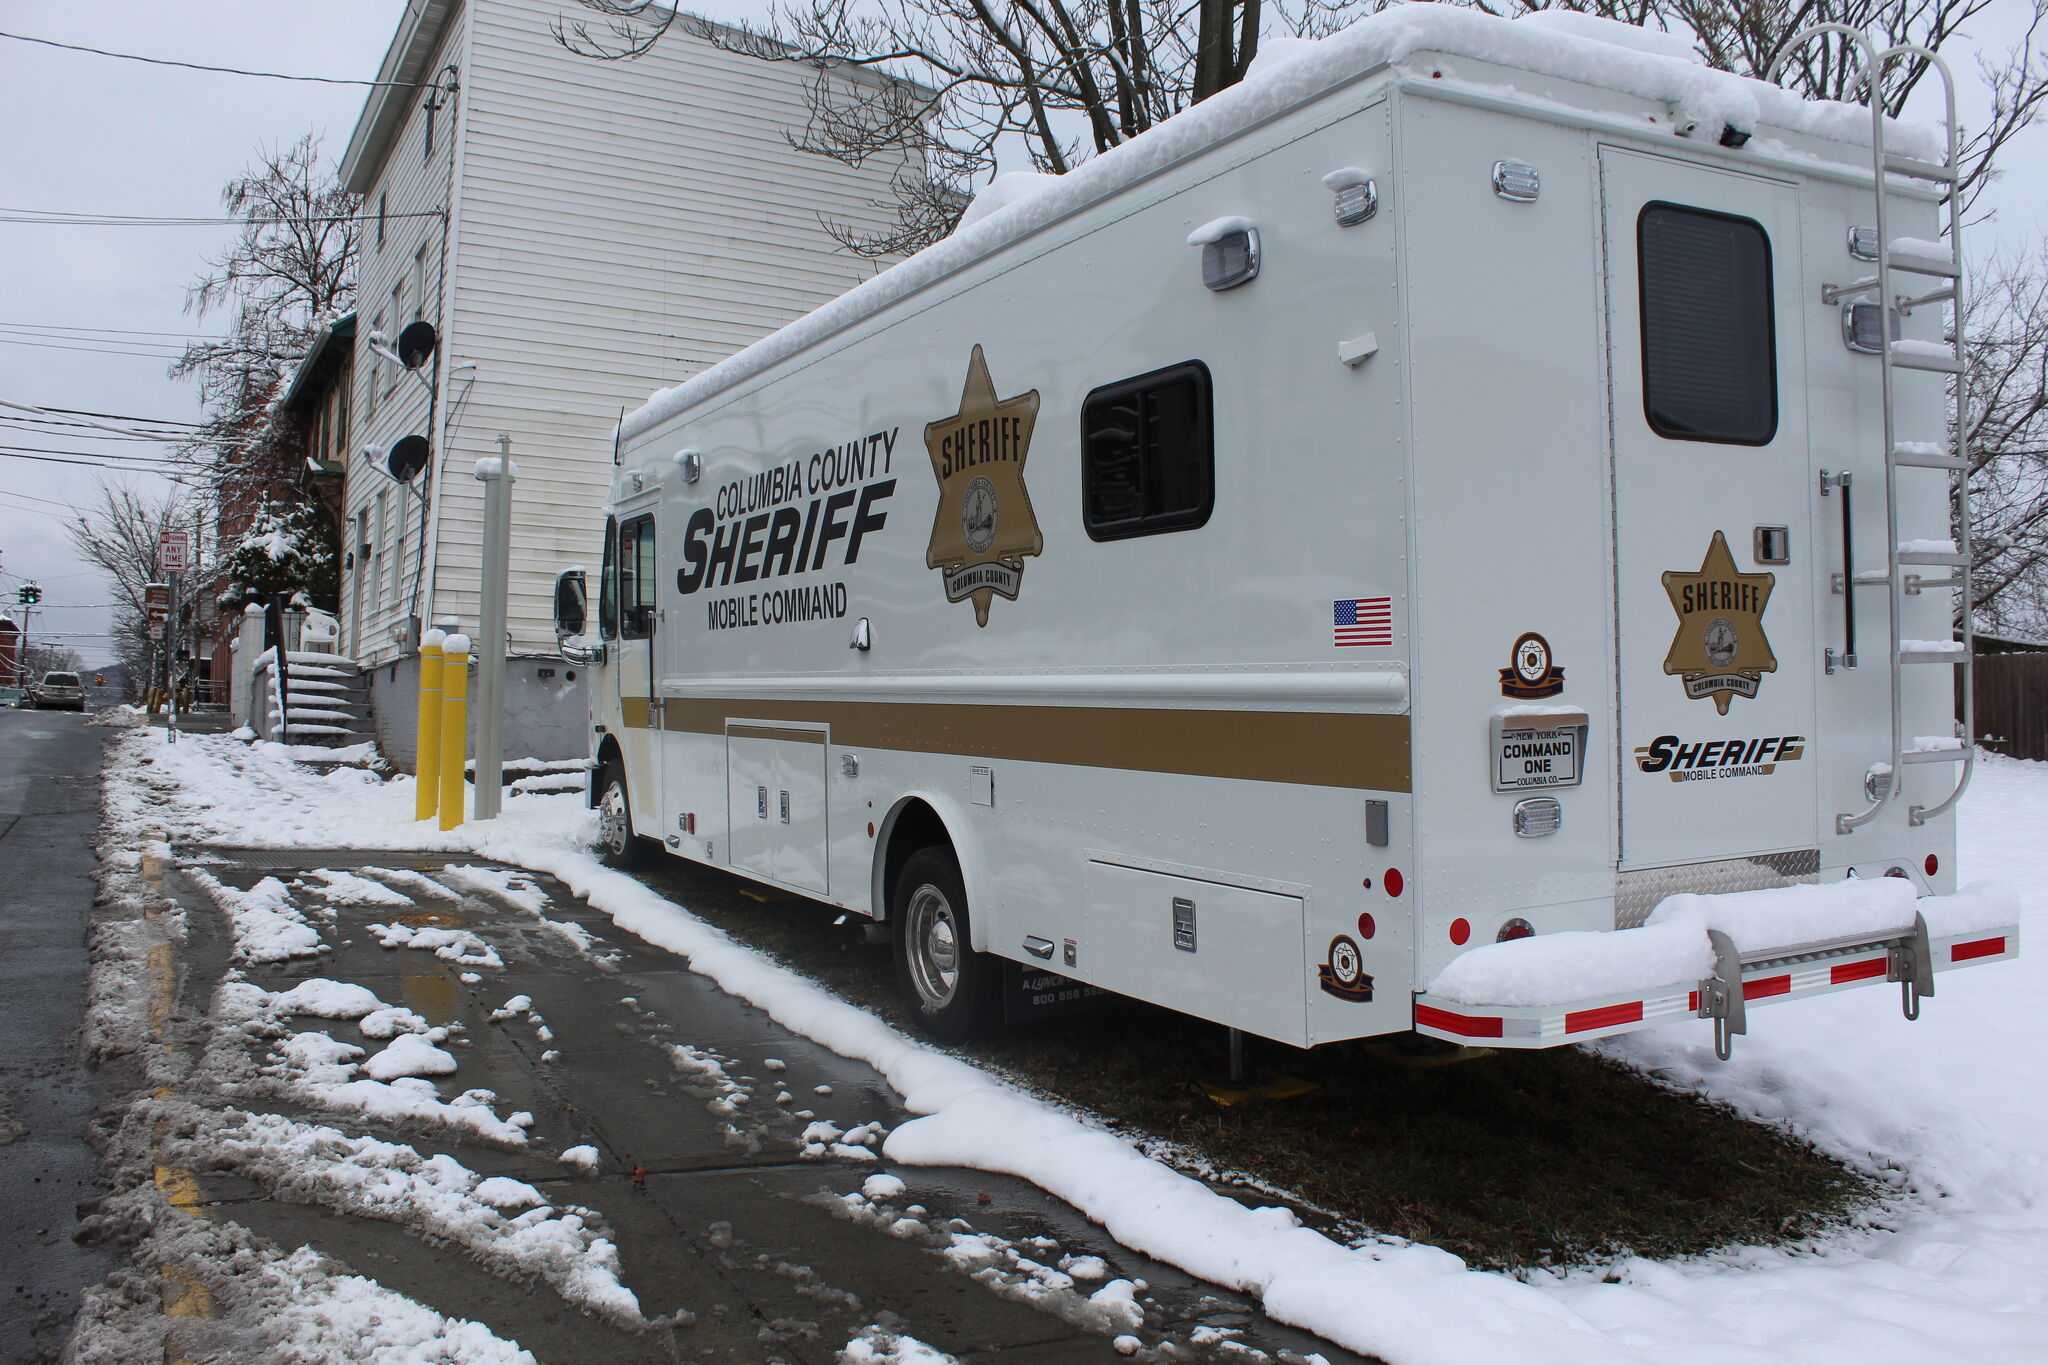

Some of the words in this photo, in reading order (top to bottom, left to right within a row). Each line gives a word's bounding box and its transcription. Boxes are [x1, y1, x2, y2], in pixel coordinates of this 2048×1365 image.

[942, 417, 1020, 480] SHERIFF
[716, 461, 802, 521] COLUMBIA
[808, 427, 899, 495] COUNTY
[677, 478, 898, 595] SHERIFF
[165, 555, 182, 563] TIME
[952, 572, 983, 594] COLUMBIA
[985, 570, 1011, 587] COUNTY
[708, 595, 758, 630] MOBILE
[762, 582, 847, 625] COMMAND
[1682, 581, 1759, 614] SHERIFF
[1693, 678, 1724, 692] COLUMBIA
[1726, 679, 1750, 691] COUNTY
[1516, 732, 1533, 741] NEW
[1536, 730, 1558, 740] YORK
[1503, 742, 1571, 759] COMMAND
[1641, 735, 1800, 773] SHERIFF
[1524, 759, 1552, 774] ONE
[1683, 769, 1717, 782] MOBILE
[1719, 765, 1764, 778] COMMAND
[1517, 776, 1547, 786] COLUMBIA
[1548, 776, 1559, 784] CO.
[1033, 993, 1055, 1006] 800
